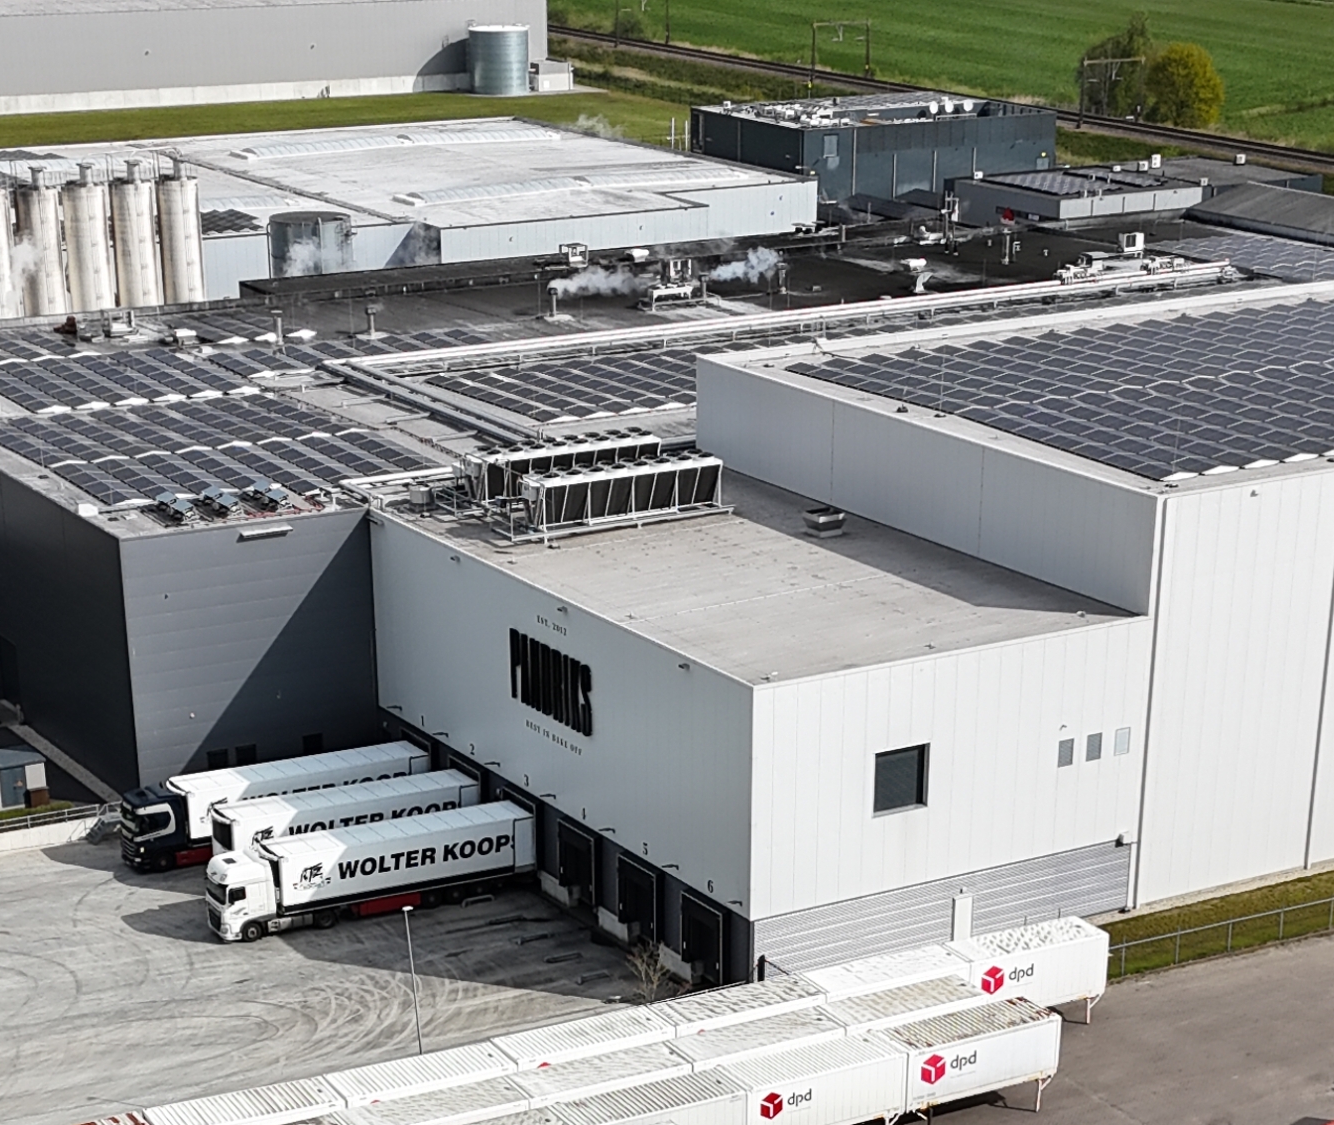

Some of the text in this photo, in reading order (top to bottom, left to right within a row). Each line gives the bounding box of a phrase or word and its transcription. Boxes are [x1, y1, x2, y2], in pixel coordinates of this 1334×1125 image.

[525, 719, 541, 734] BEST
[469, 743, 476, 756] 2
[523, 774, 530, 787] 3
[642, 842, 649, 856] 5
[337, 847, 437, 880] WOLTER
[707, 879, 714, 894] 6
[1008, 963, 1035, 983] dpd
[949, 1049, 977, 1071] dpd
[787, 1088, 813, 1107] dpd
